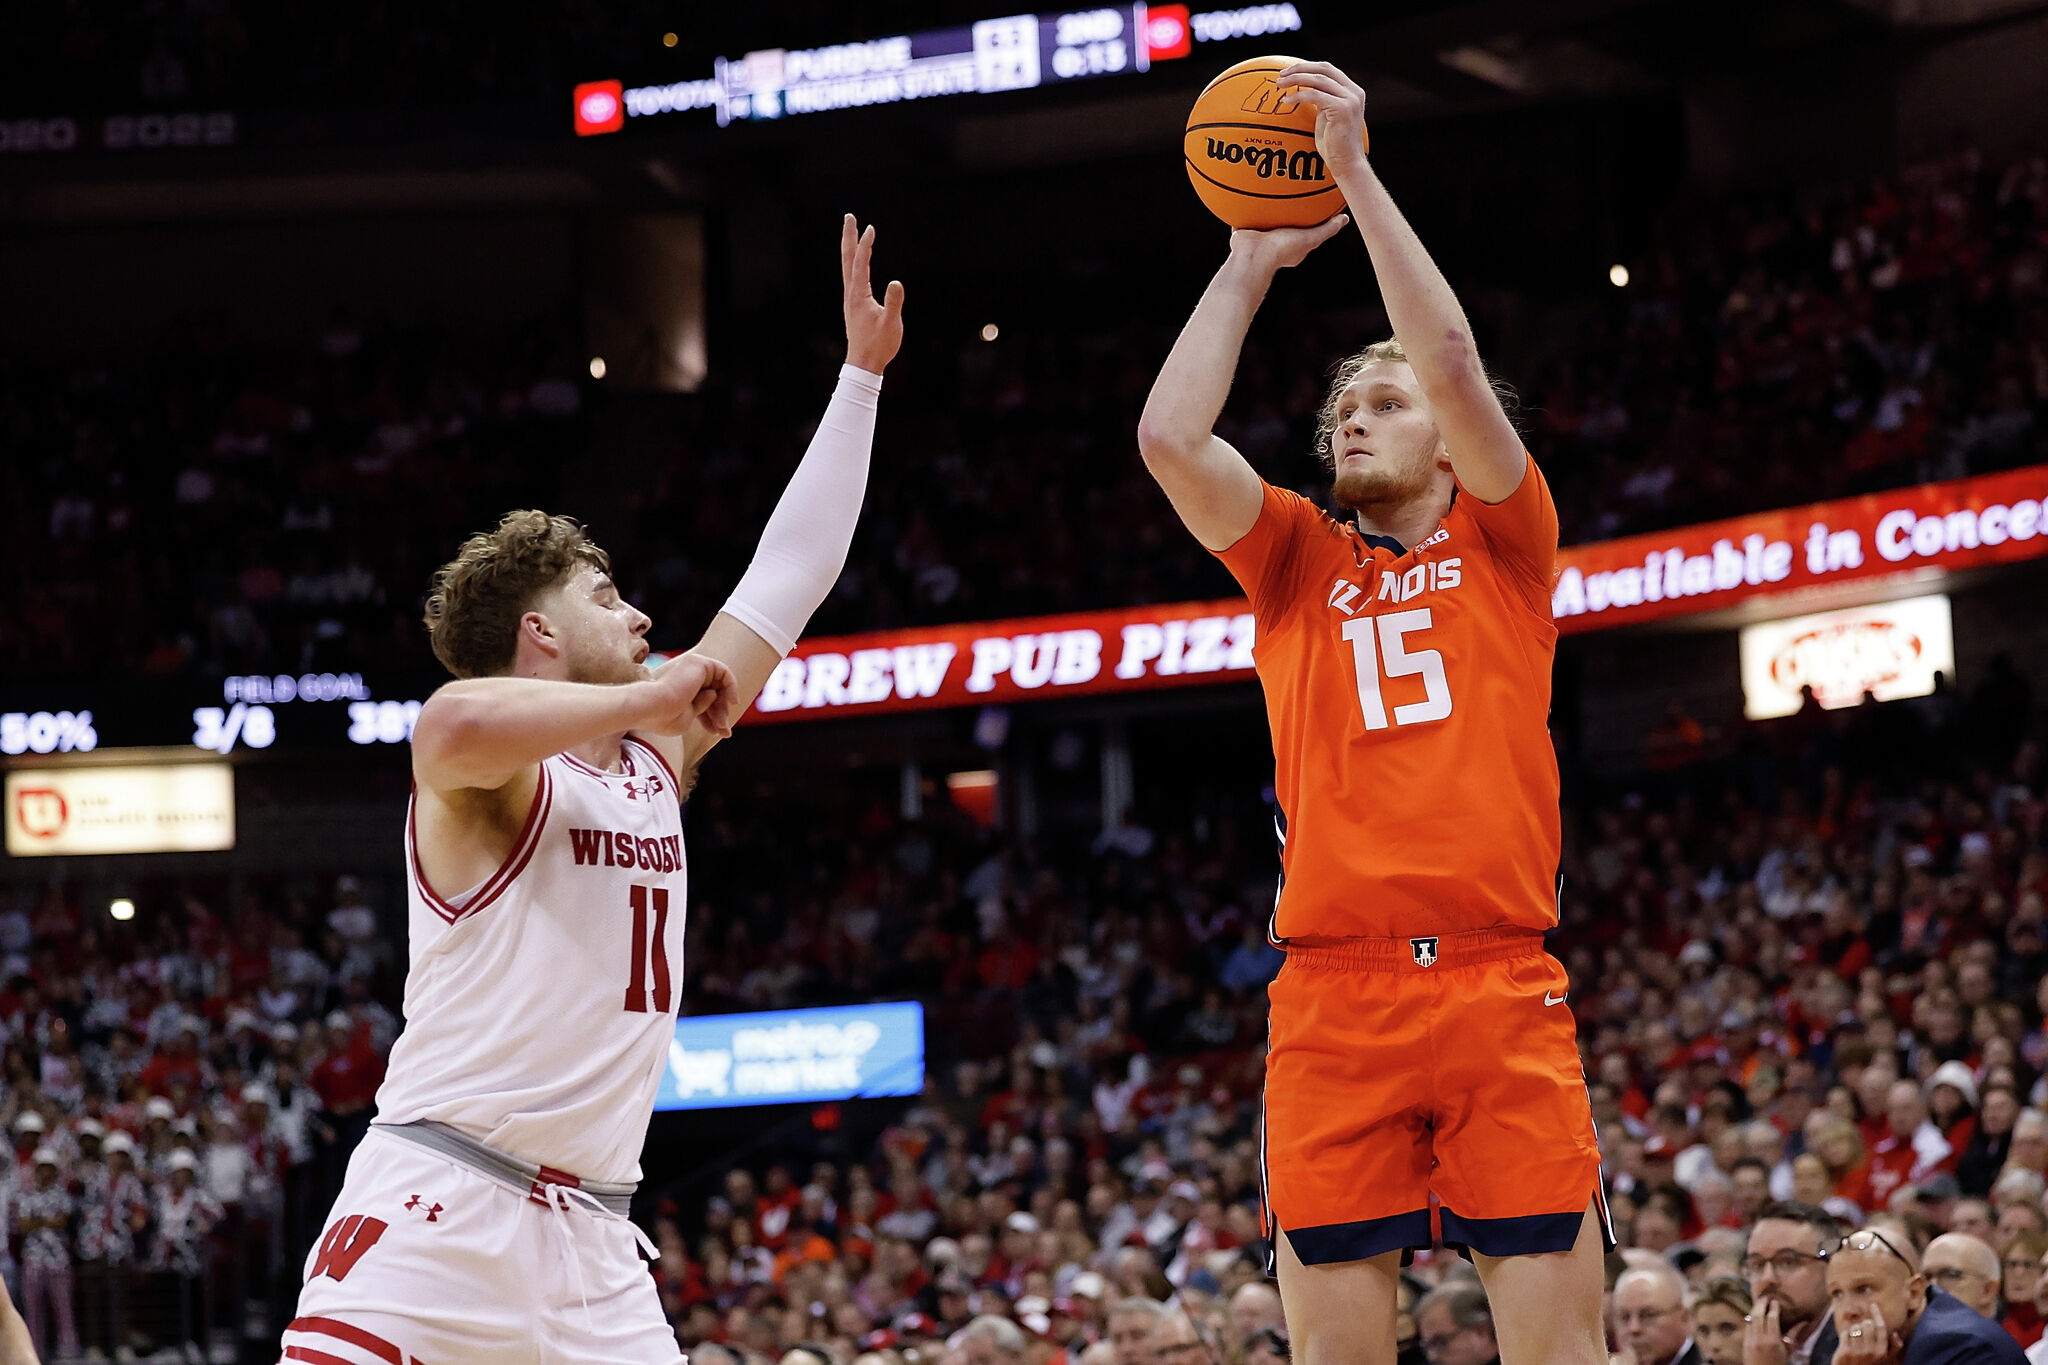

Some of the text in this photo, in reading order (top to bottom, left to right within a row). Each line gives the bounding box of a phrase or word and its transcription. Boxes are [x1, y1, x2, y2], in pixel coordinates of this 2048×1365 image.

[1206, 137, 1326, 181] Wilson
[1552, 533, 1793, 619] Available
[1804, 521, 1865, 575] in
[756, 641, 957, 713] BREW
[966, 628, 1102, 694] PUB
[1342, 607, 1453, 731] 15
[623, 884, 672, 1014] 11
[308, 1214, 389, 1284] W
